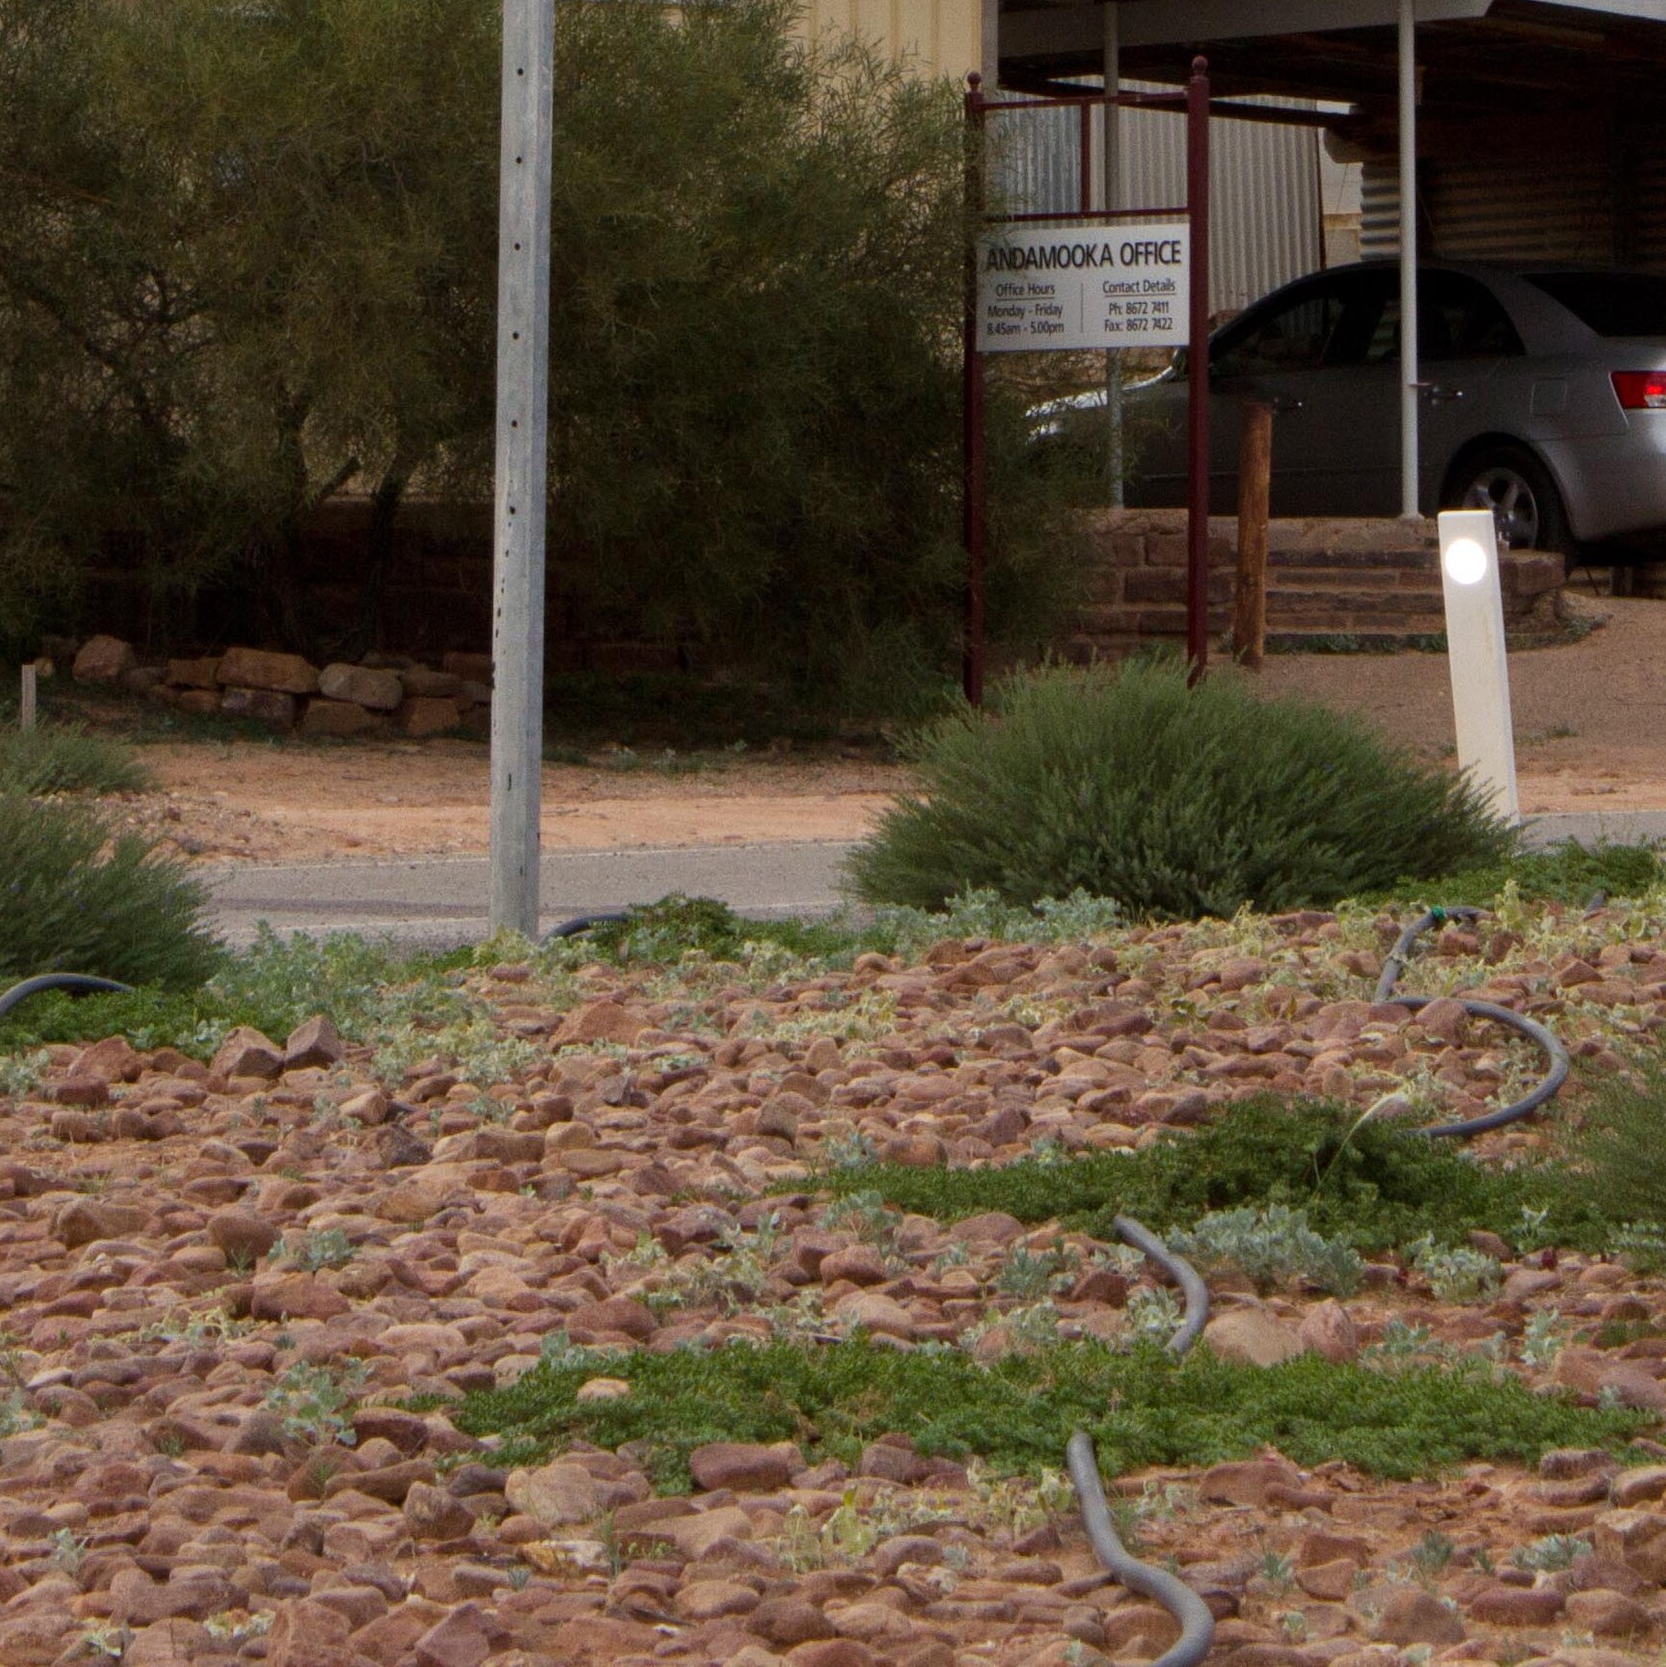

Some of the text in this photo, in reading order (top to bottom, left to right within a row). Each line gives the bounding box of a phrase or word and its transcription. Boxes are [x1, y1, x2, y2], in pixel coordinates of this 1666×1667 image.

[986, 240, 1181, 272] ANDAMOOKA OFFICE
[996, 283, 1055, 297] Office Hours
[1102, 278, 1176, 294] Contact Details
[987, 304, 1025, 319] Monday
[1035, 303, 1063, 319] Friday
[1125, 301, 1148, 314] 8672
[1151, 301, 1170, 314] 7411
[1126, 319, 1148, 332] 8672
[1152, 318, 1173, 331] 7422
